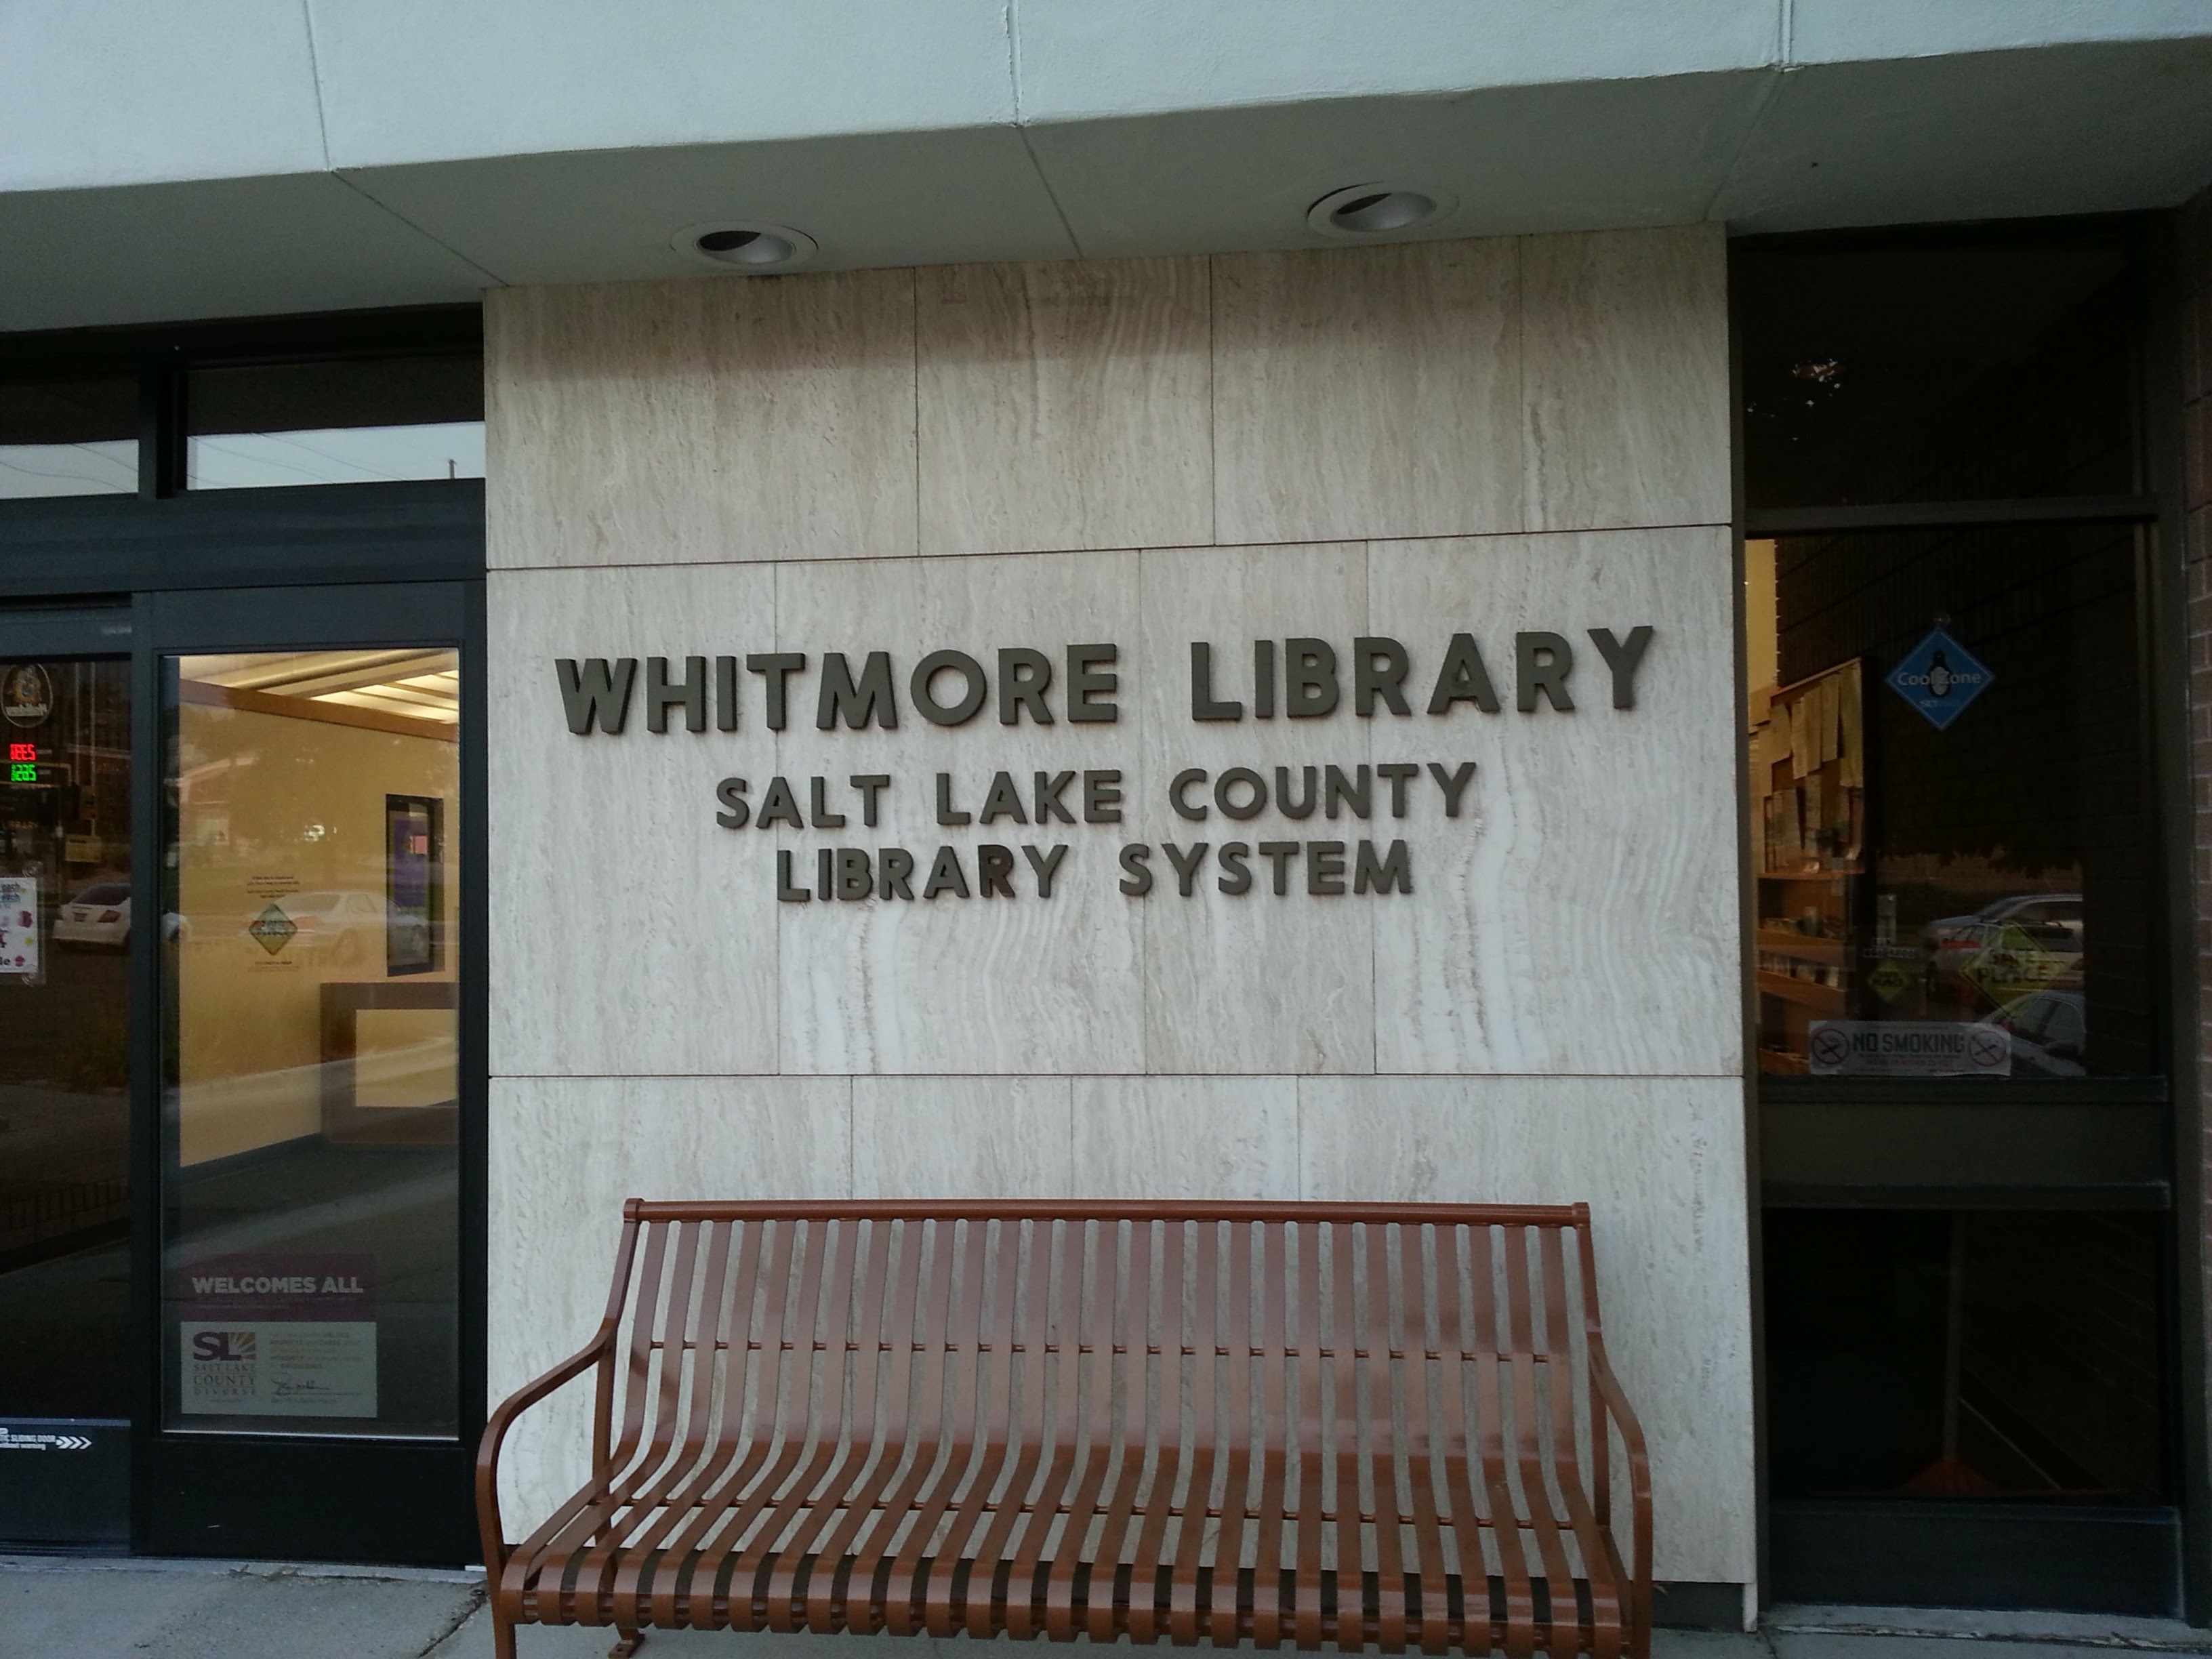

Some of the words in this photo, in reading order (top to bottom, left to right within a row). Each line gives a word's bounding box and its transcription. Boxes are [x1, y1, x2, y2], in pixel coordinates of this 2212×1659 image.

[555, 643, 1118, 735] WHITMORE
[1191, 626, 1654, 721] LIBRARY
[716, 774, 890, 829] SALT
[936, 770, 1122, 826] LAKE
[1168, 761, 1477, 821] COUNTY
[777, 844, 1069, 903] LIBRARY
[1119, 839, 1412, 897] SYSTEM
[1852, 1032, 1879, 1052] NO
[1882, 1032, 1965, 1053] SMOKING
[191, 1277, 316, 1294] WELCOMES
[321, 1276, 364, 1294] ALL
[193, 1375, 255, 1385] COUNTY
